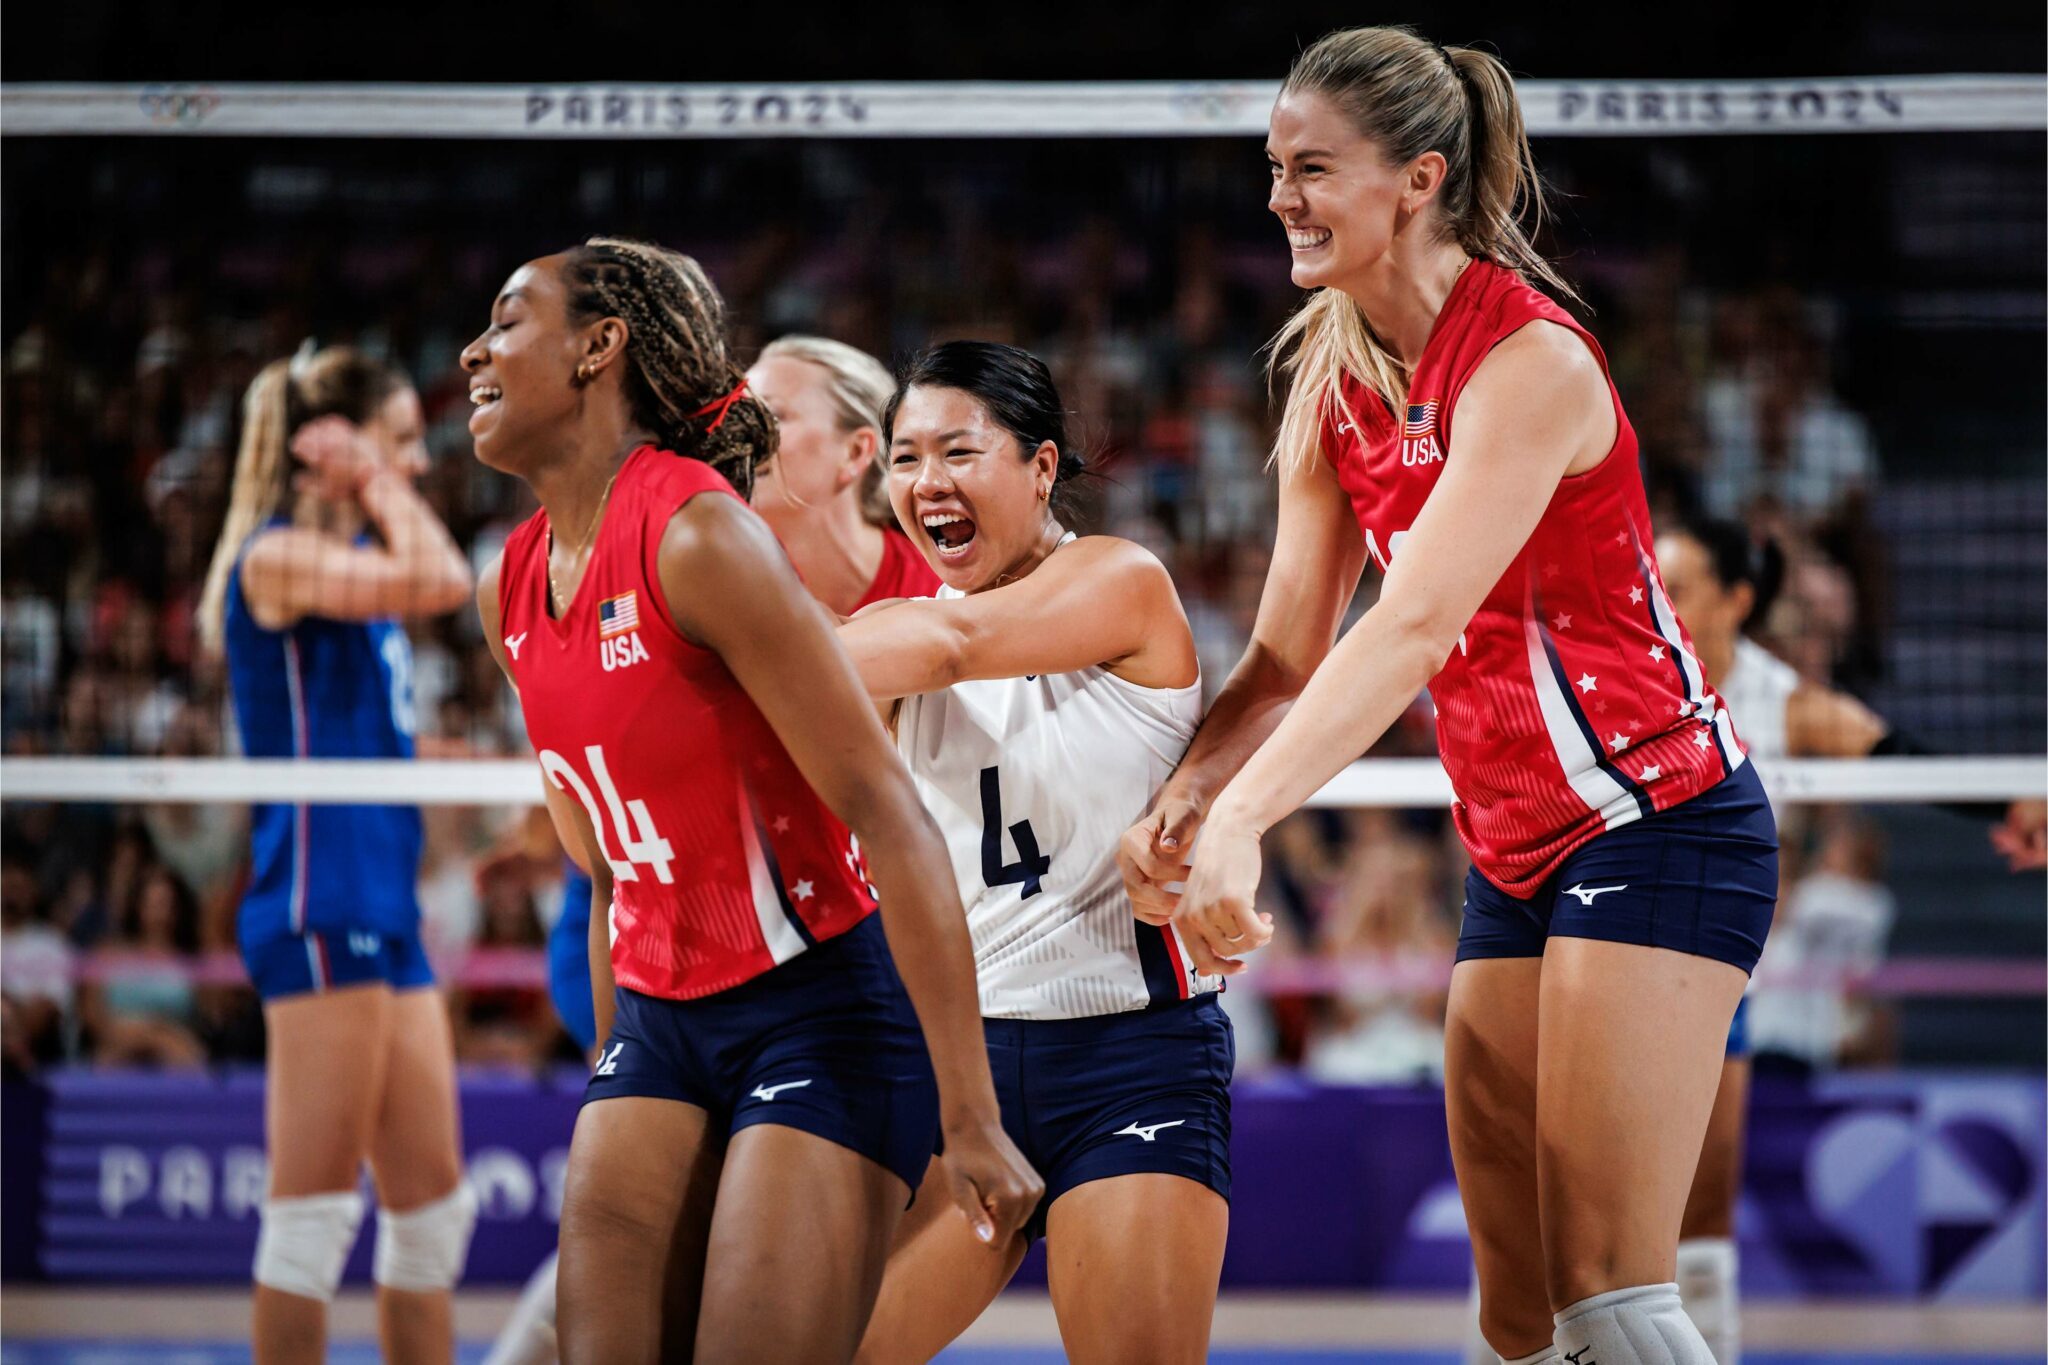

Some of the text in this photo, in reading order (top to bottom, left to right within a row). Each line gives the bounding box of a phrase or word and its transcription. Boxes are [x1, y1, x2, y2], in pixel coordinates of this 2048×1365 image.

[526, 93, 869, 127] PARIS 2024
[1558, 89, 1902, 122] PARIS 2024
[1402, 434, 1443, 467] USA
[600, 630, 650, 672] USA
[539, 744, 676, 884] 24
[980, 765, 1051, 901] 4
[101, 1145, 271, 1219] PAR
